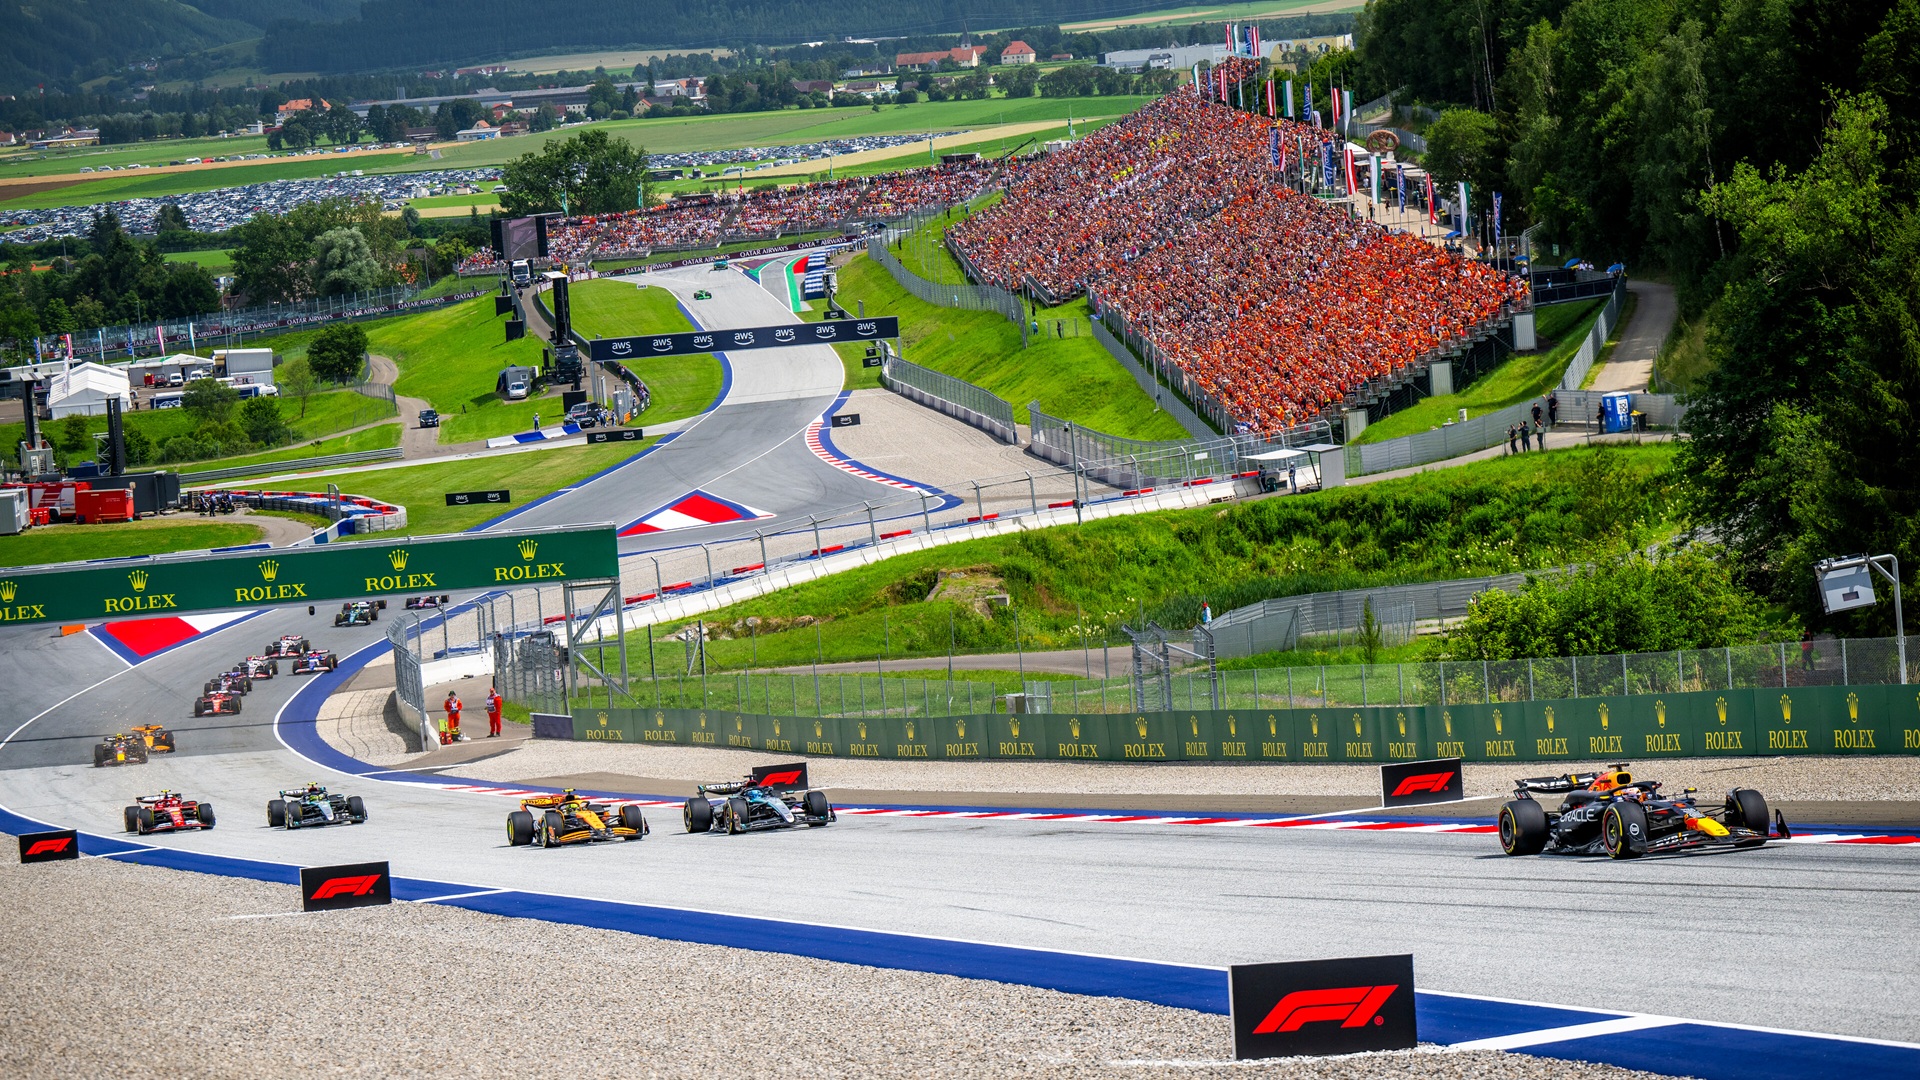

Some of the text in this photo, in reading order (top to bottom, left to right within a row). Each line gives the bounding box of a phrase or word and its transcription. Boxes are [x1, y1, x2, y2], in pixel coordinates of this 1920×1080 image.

[820, 236, 847, 246] AIRWAYS
[740, 246, 789, 258] QATAR AIRWAYS
[682, 258, 703, 266] QATAR
[398, 297, 445, 309] QATAR AIRWAYS
[454, 292, 475, 300] QATAR
[364, 306, 389, 315] AIRWAYS
[309, 314, 333, 323] AIRWAYS
[198, 330, 222, 338] AIRWAYS
[232, 322, 278, 334] QATAR AIRWAYS
[105, 593, 176, 613] ROLEX
[237, 583, 307, 602] ROLEX
[366, 573, 437, 592] ROLEX
[494, 563, 565, 581] ROLEX
[586, 729, 623, 741] ROLEX
[644, 730, 675, 742] ROLEX
[692, 732, 716, 744] ROLEX
[728, 735, 751, 747] ROLEX
[1705, 731, 1743, 750] ROLEX
[1769, 730, 1809, 749] ROLEX
[1834, 729, 1876, 749] ROLEX
[766, 739, 791, 751] ROLEX
[807, 741, 833, 754] ROLEX
[850, 744, 879, 756] ROLEX
[945, 743, 979, 756] ROLEX
[1000, 742, 1035, 756] ROLEX
[1058, 743, 1098, 757] ROLEX
[1185, 742, 1207, 756] ROLEX
[1222, 742, 1247, 757] ROLEX
[1262, 742, 1287, 757] ROLEX
[1303, 742, 1328, 757] ROLEX
[1346, 742, 1373, 758] ROLEX
[1389, 742, 1417, 758] ROLEX
[1437, 742, 1466, 758] ROLEX
[1485, 740, 1516, 757] ROLEX
[1537, 738, 1569, 755] ROLEX
[1590, 736, 1623, 753] ROLEX
[1646, 734, 1681, 752] ROLEX
[897, 745, 928, 757] ROLEX
[1124, 743, 1166, 758] ROLEX
[759, 770, 802, 787] F1
[1391, 771, 1455, 797] F1
[1560, 808, 1598, 822] ORACLE
[26, 837, 72, 855] F1
[310, 874, 381, 900] F1
[1252, 984, 1399, 1034] F1
